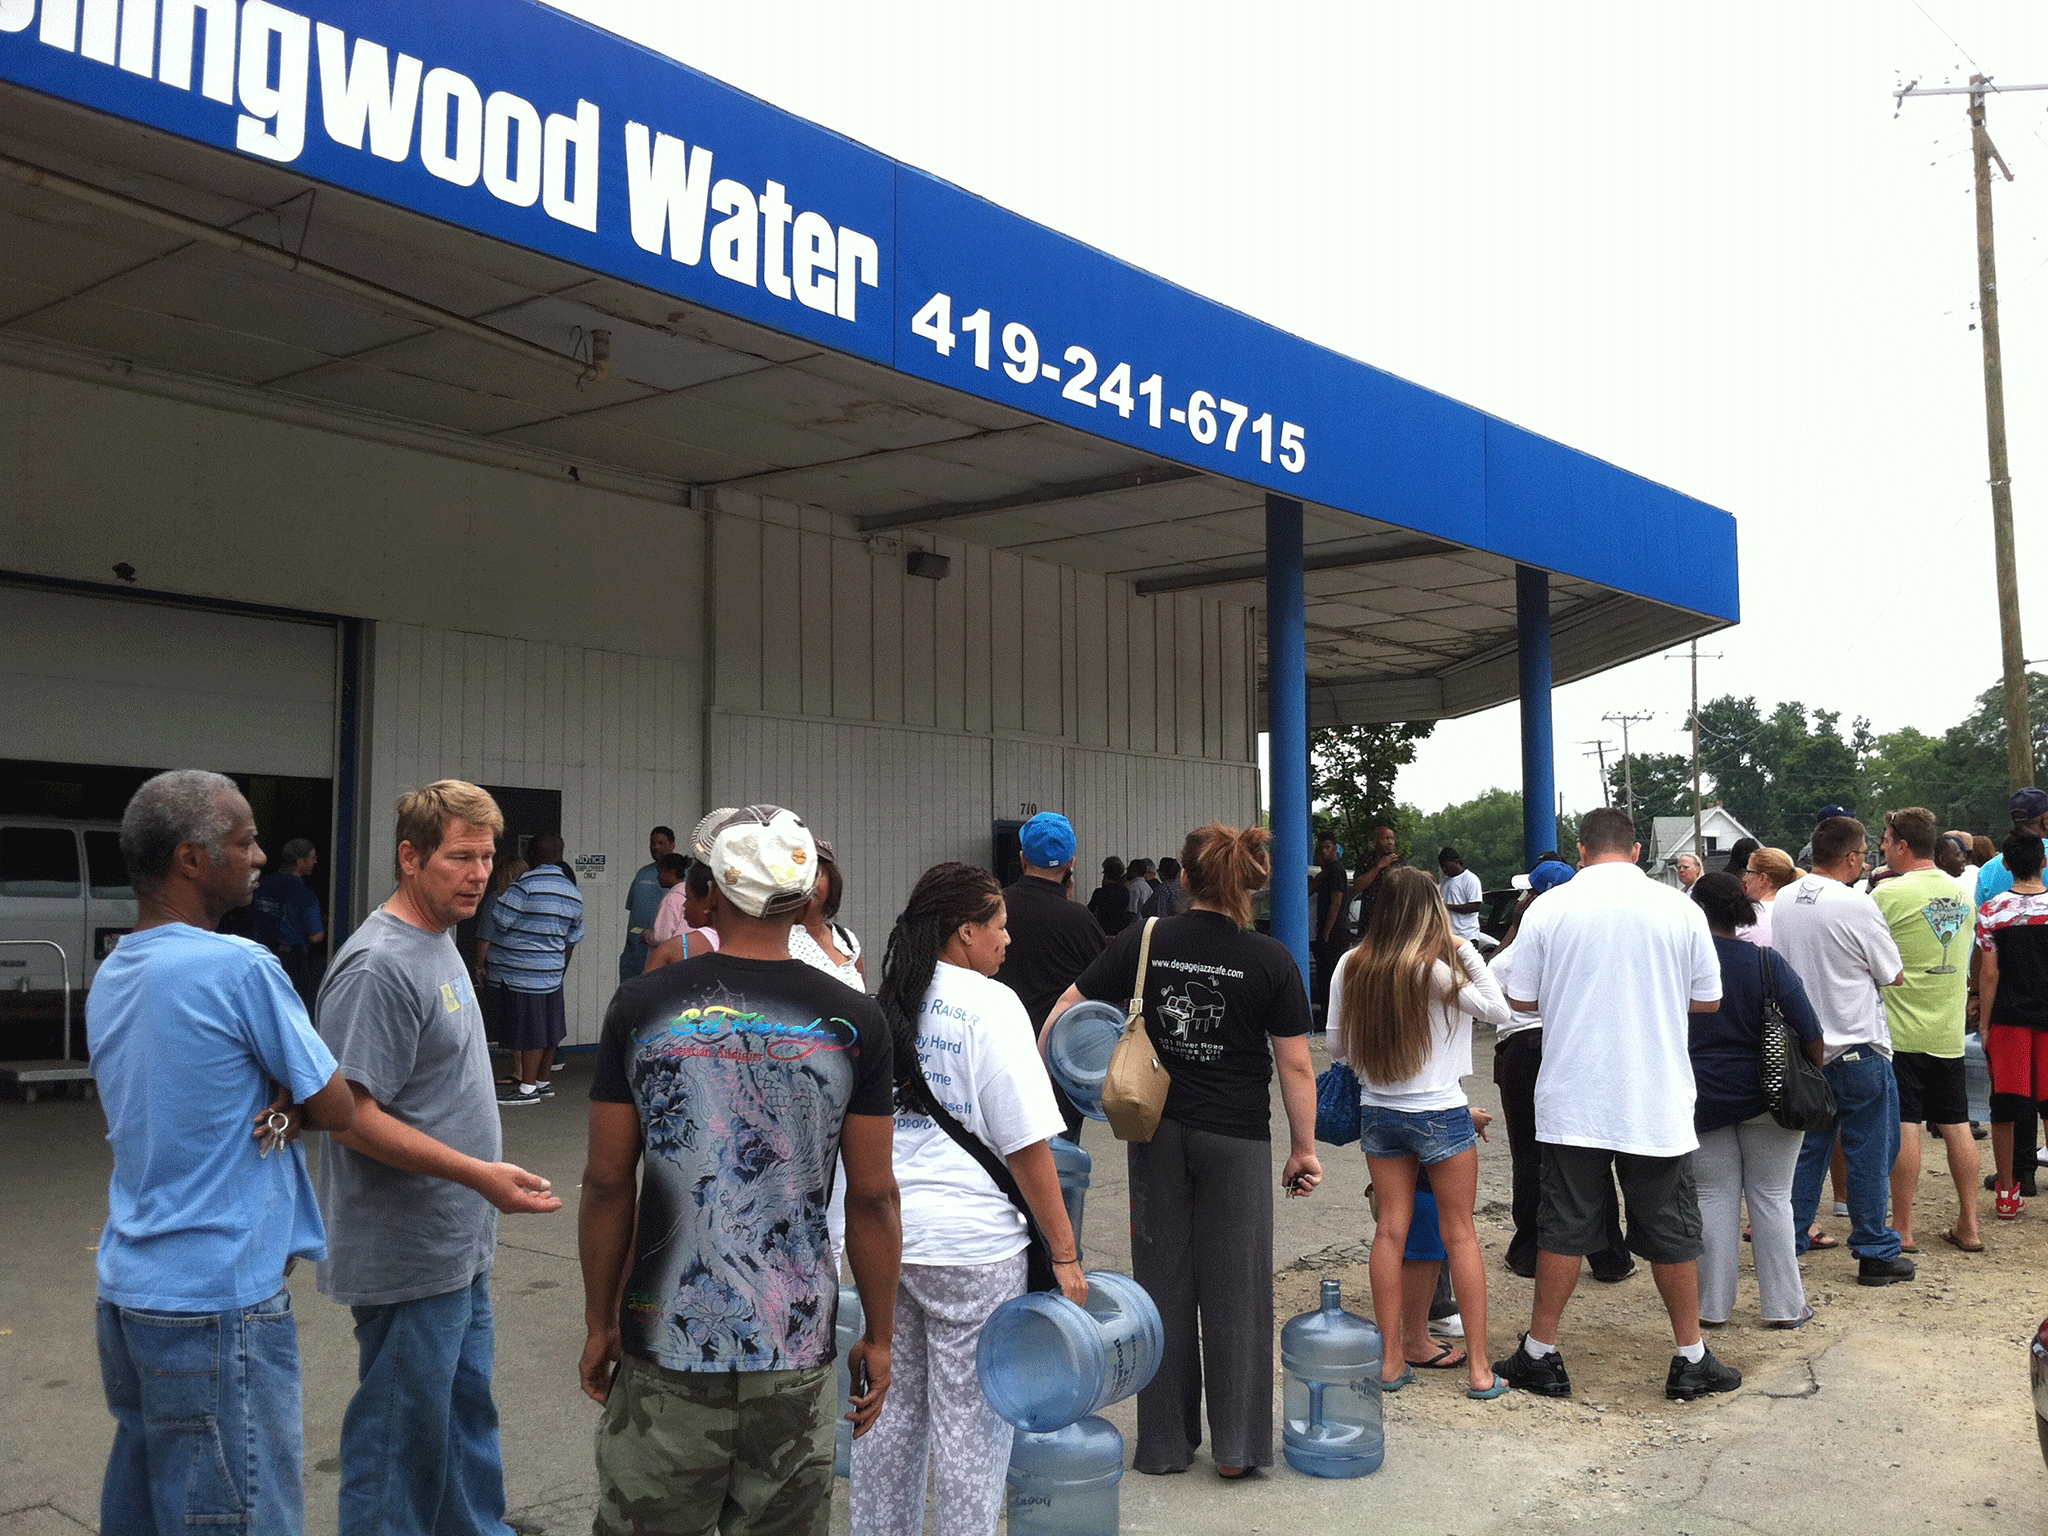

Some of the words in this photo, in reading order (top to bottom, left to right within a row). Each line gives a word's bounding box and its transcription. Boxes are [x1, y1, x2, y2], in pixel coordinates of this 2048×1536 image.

[0, 0, 599, 233] ngwood
[625, 120, 879, 323] Water
[911, 291, 1306, 474] 419-241-6715
[1020, 802, 1037, 816] 710
[576, 854, 606, 864] NOTICE
[1151, 959, 1244, 979] www.degagejazzcafe.com
[930, 1034, 962, 1054] Hard
